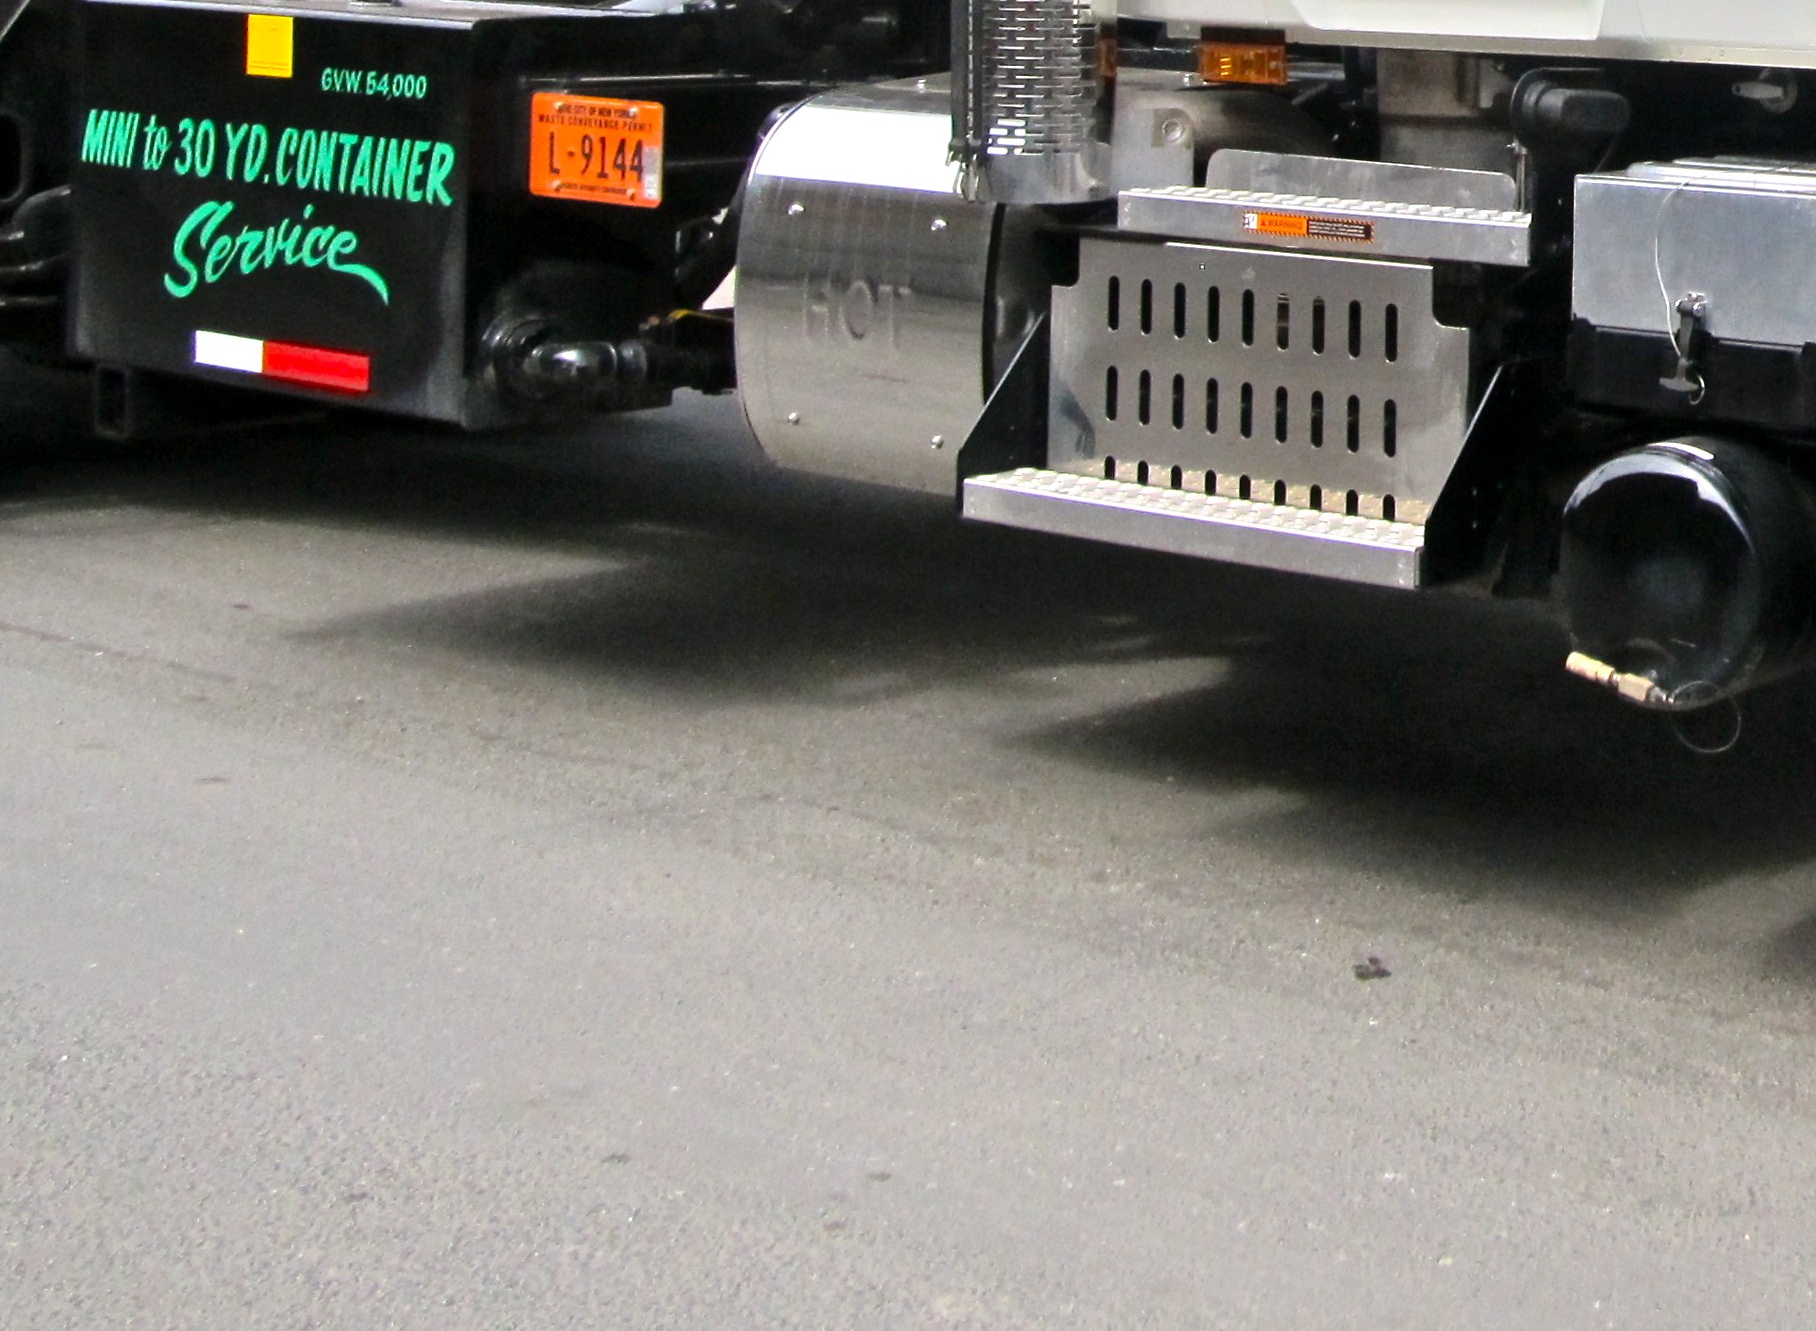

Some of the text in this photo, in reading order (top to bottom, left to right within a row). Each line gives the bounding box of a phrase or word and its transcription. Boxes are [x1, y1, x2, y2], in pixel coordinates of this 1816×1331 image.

[81, 108, 456, 207] MINI to 30 YD. CONTAINER
[538, 114, 565, 126] WASTE
[567, 115, 619, 130] CONVEYANCE
[549, 130, 644, 183] L-9144
[163, 200, 390, 306] Service
